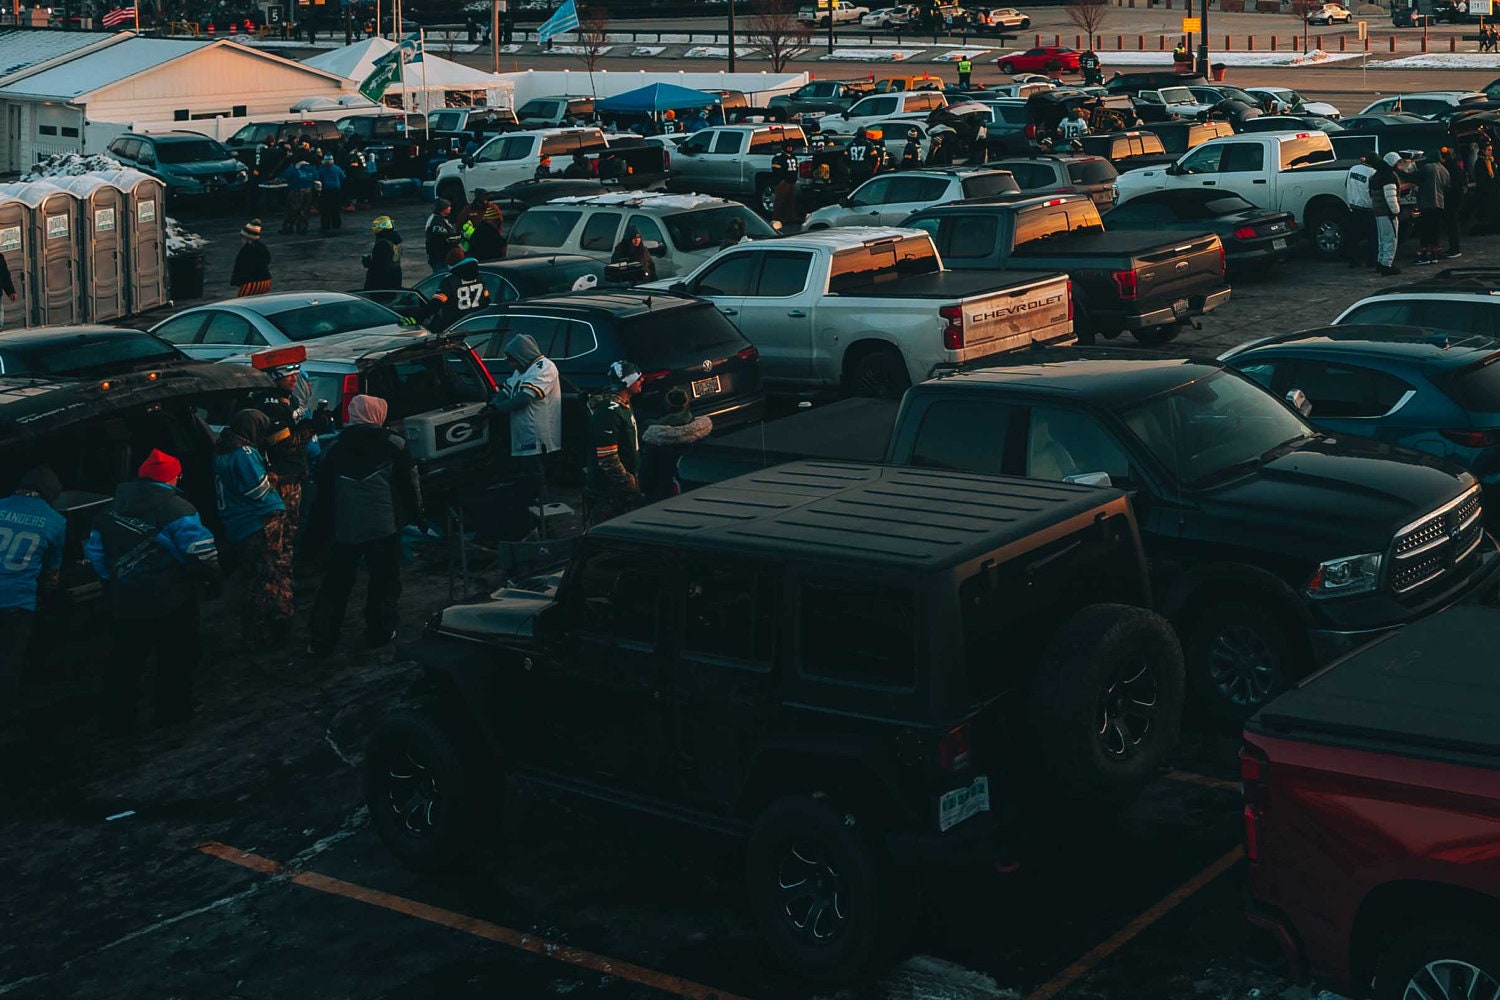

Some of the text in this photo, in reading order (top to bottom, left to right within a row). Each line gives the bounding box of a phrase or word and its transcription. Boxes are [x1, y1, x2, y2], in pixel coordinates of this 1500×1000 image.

[272, 12, 279, 22] 5
[1064, 125, 1076, 139] 12
[850, 146, 865, 161] 87
[457, 283, 483, 311] 87
[972, 294, 1065, 324] CHEVROLET
[536, 360, 544, 369] 4
[445, 422, 473, 442] G
[0, 510, 47, 528] SANDERS
